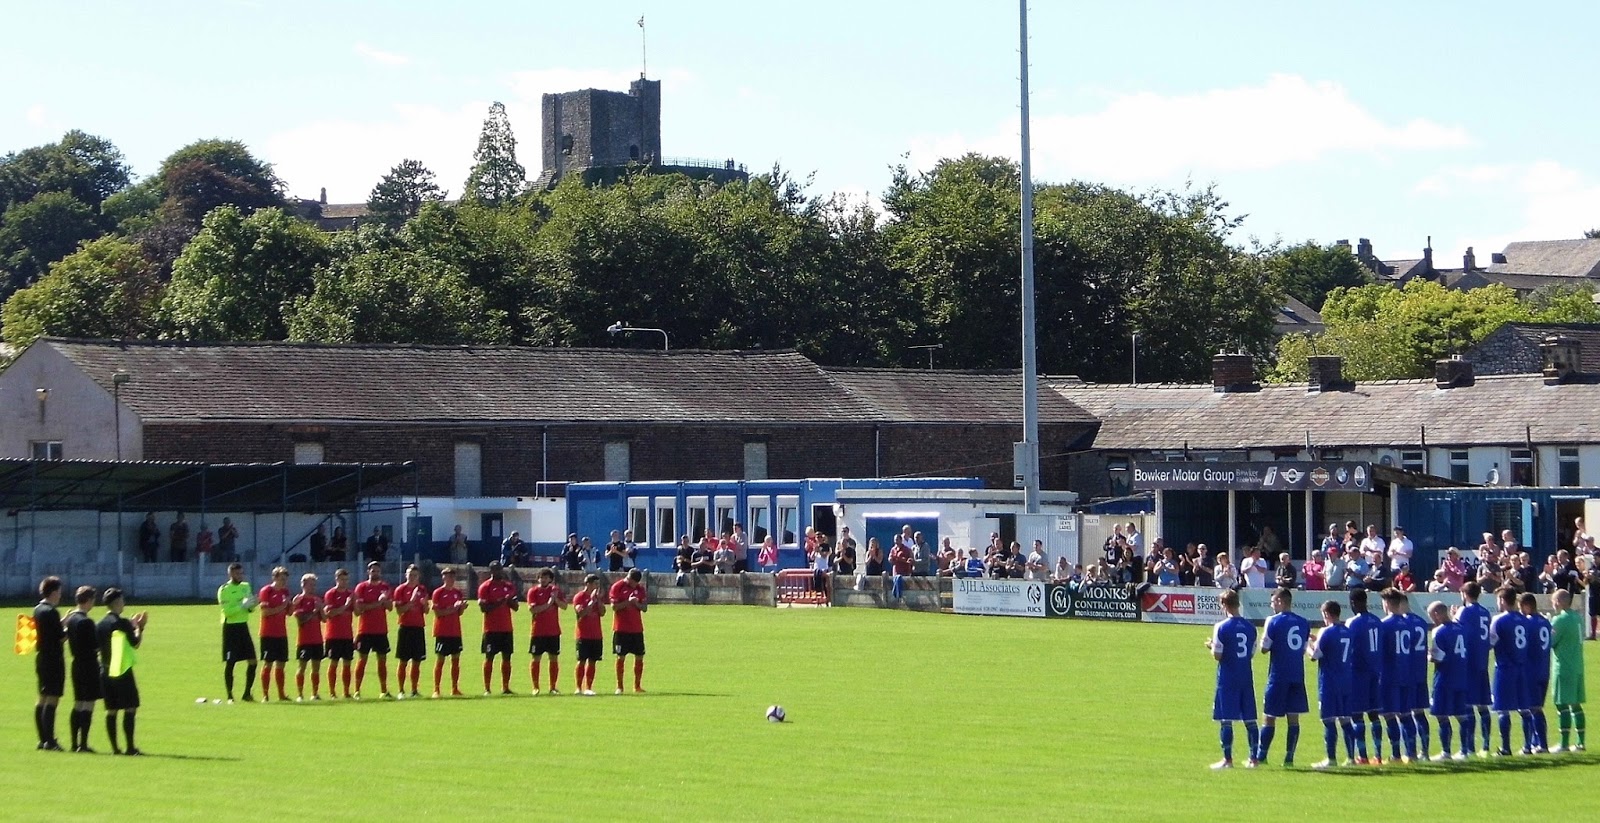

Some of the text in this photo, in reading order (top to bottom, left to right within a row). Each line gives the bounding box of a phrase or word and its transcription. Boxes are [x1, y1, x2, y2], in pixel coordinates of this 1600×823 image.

[1134, 468, 1234, 484] Bowker Motor Group
[959, 580, 1020, 594] AJH Associates
[1083, 587, 1128, 600] MONKS
[1074, 600, 1137, 611] CONTRACTORS
[1074, 610, 1137, 619] monkscontractors.com
[1172, 600, 1193, 608] AKOA
[1197, 602, 1221, 610] SPORTS
[1287, 625, 1302, 650] 6
[1368, 627, 1379, 652] 11
[1414, 626, 1426, 651] 2
[1479, 616, 1489, 640] 5
[1514, 625, 1527, 649] 8
[1539, 626, 1550, 650] 9
[1236, 632, 1248, 658] 3
[1340, 637, 1351, 663] 7
[1395, 629, 1411, 655] 10
[1454, 634, 1467, 659] 4
